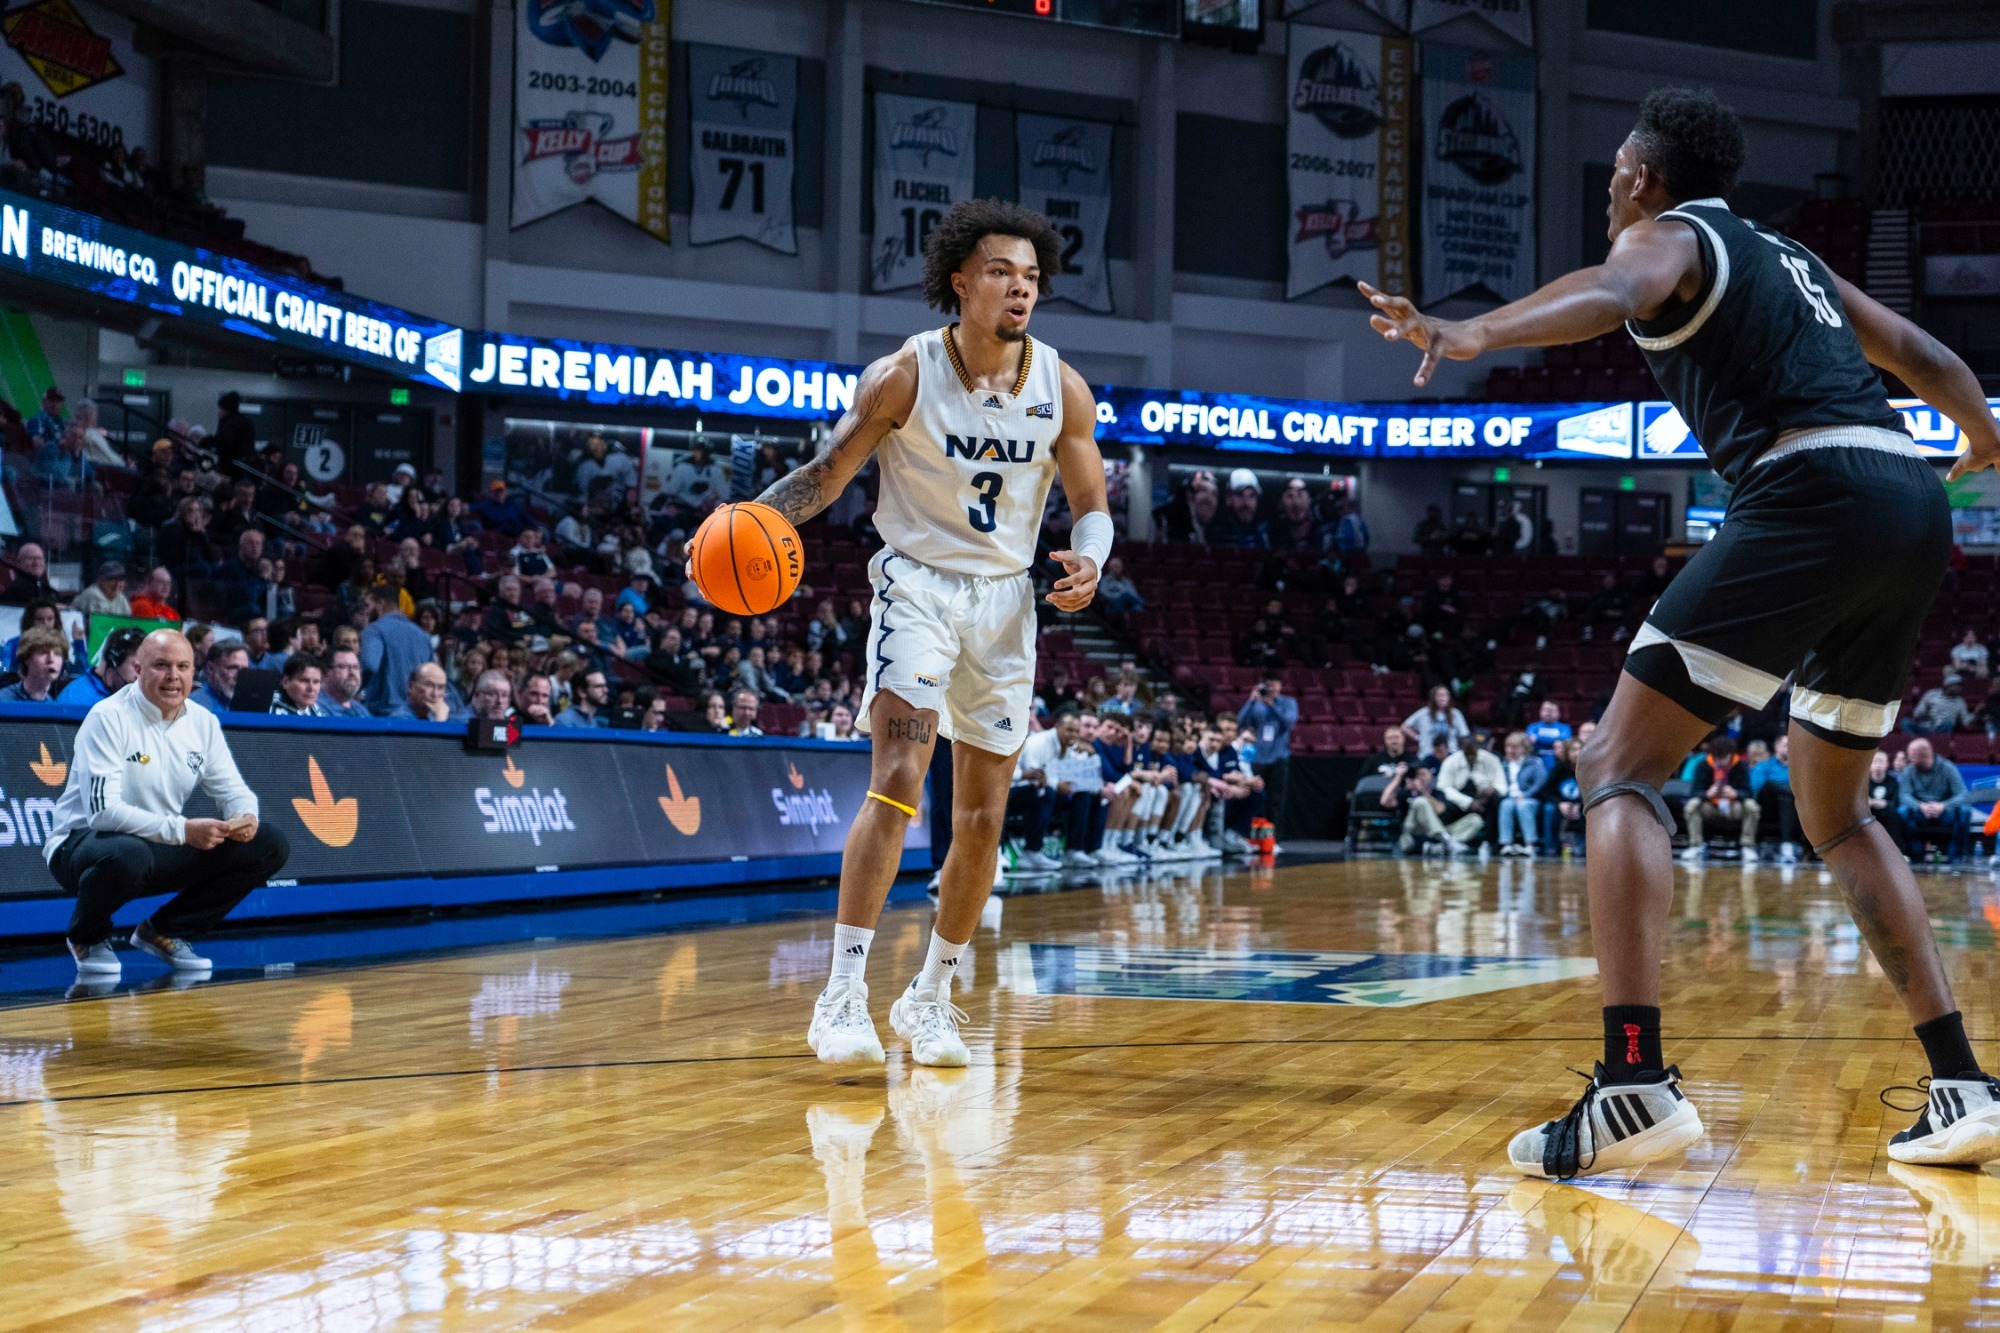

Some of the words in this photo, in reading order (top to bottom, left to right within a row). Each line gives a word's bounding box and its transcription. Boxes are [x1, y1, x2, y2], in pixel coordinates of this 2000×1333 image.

[529, 71, 637, 98] 2003-2004
[536, 129, 588, 156] KELLY
[598, 141, 632, 162] CUP
[702, 131, 786, 157] GALBRAITH
[719, 159, 764, 213] 71
[41, 227, 126, 276] BREWING
[129, 253, 160, 286] CO.
[172, 261, 271, 324] OFFICIAL
[275, 291, 342, 342] CRAFT
[344, 311, 393, 358] BEER
[395, 327, 421, 364] OF
[470, 343, 713, 400] JEREMIAH
[728, 365, 857, 411] JOHN
[1141, 400, 1276, 440] OFFICIAL
[1283, 411, 1377, 446] CRAFT
[1386, 417, 1475, 447] BEER
[1483, 417, 1533, 447] OF
[321, 449, 331, 471] 2
[945, 434, 1035, 463] NAU
[968, 471, 1003, 533] 3
[780, 536, 799, 578] EVO
[474, 787, 576, 847] Simplot
[771, 787, 839, 837] Simplot
